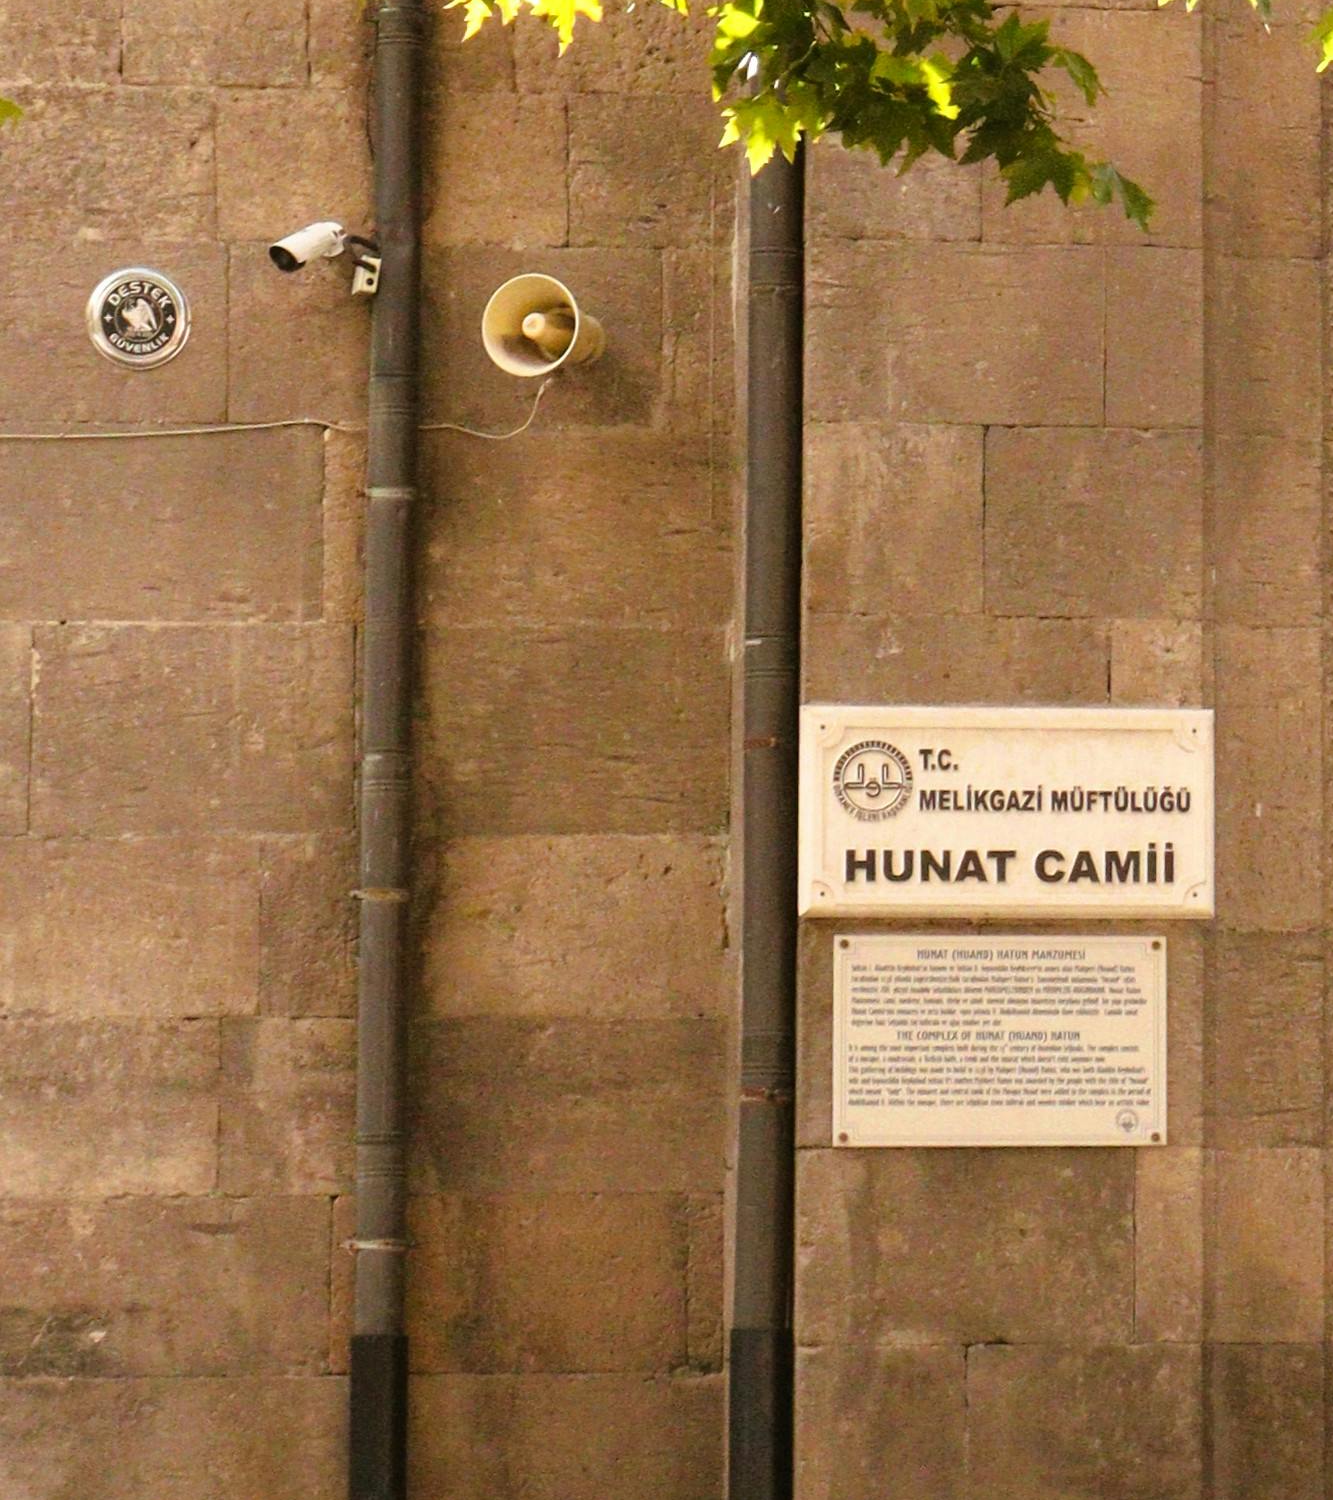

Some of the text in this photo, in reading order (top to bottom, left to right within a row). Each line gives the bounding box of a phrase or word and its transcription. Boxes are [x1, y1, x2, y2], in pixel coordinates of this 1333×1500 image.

[107, 281, 172, 308] DESTEK
[919, 749, 959, 771] T.C.
[919, 785, 1191, 813] MELİKGAZİ MÜFTÜLÜĞÜ
[845, 842, 1176, 884] HUNAT CAMİİ
[897, 1031, 913, 1040] THE
[917, 1031, 958, 1040] COMPLEX
